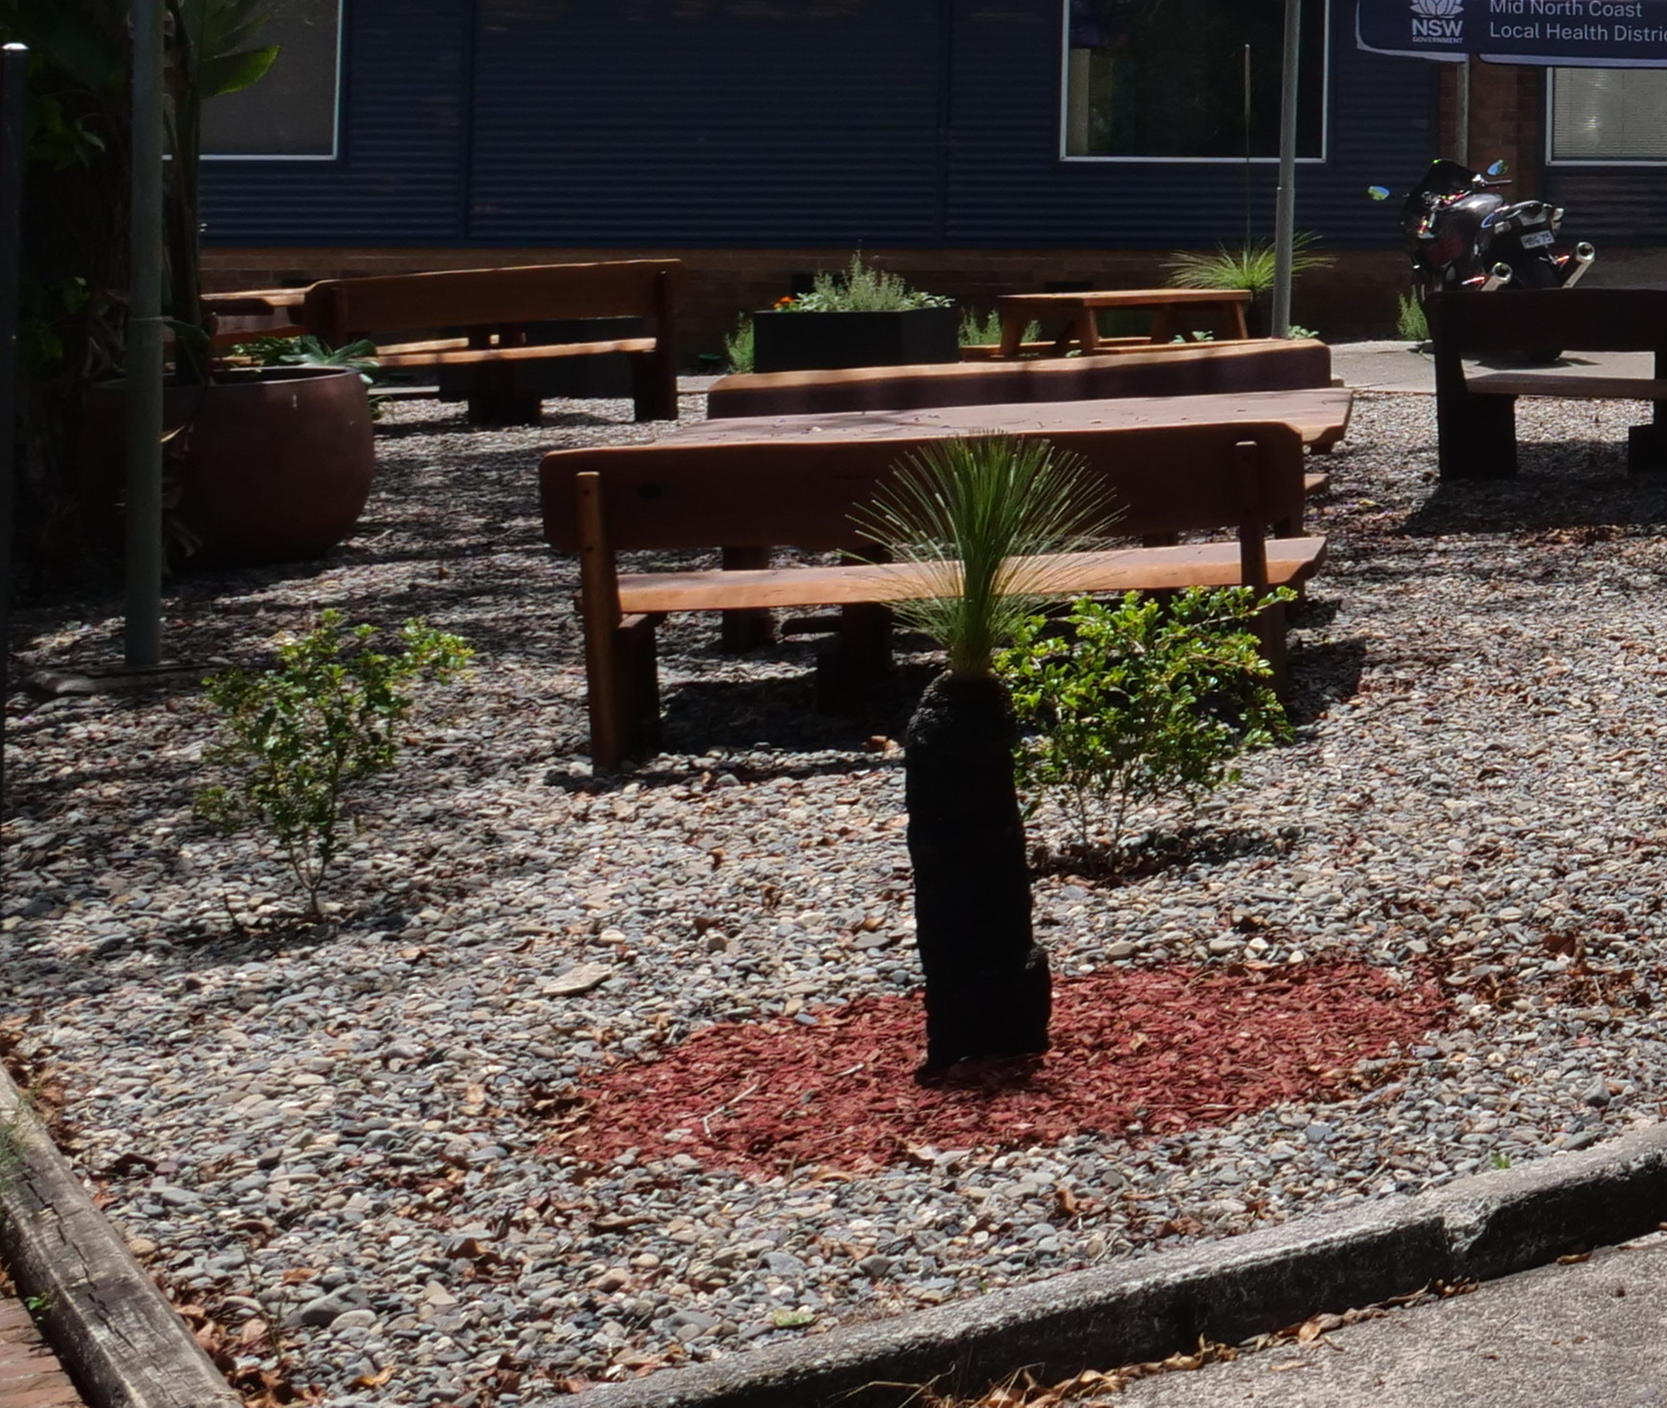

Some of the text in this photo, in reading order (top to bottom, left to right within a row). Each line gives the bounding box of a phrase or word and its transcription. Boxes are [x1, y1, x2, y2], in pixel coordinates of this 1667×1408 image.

[1530, 0, 1583, 17] North
[1588, 0, 1643, 18] Coast
[1411, 18, 1464, 37] NSW
[1489, 21, 1541, 39] Local
[1546, 23, 1608, 41] Health
[1412, 36, 1464, 44] GOVERNMENT
